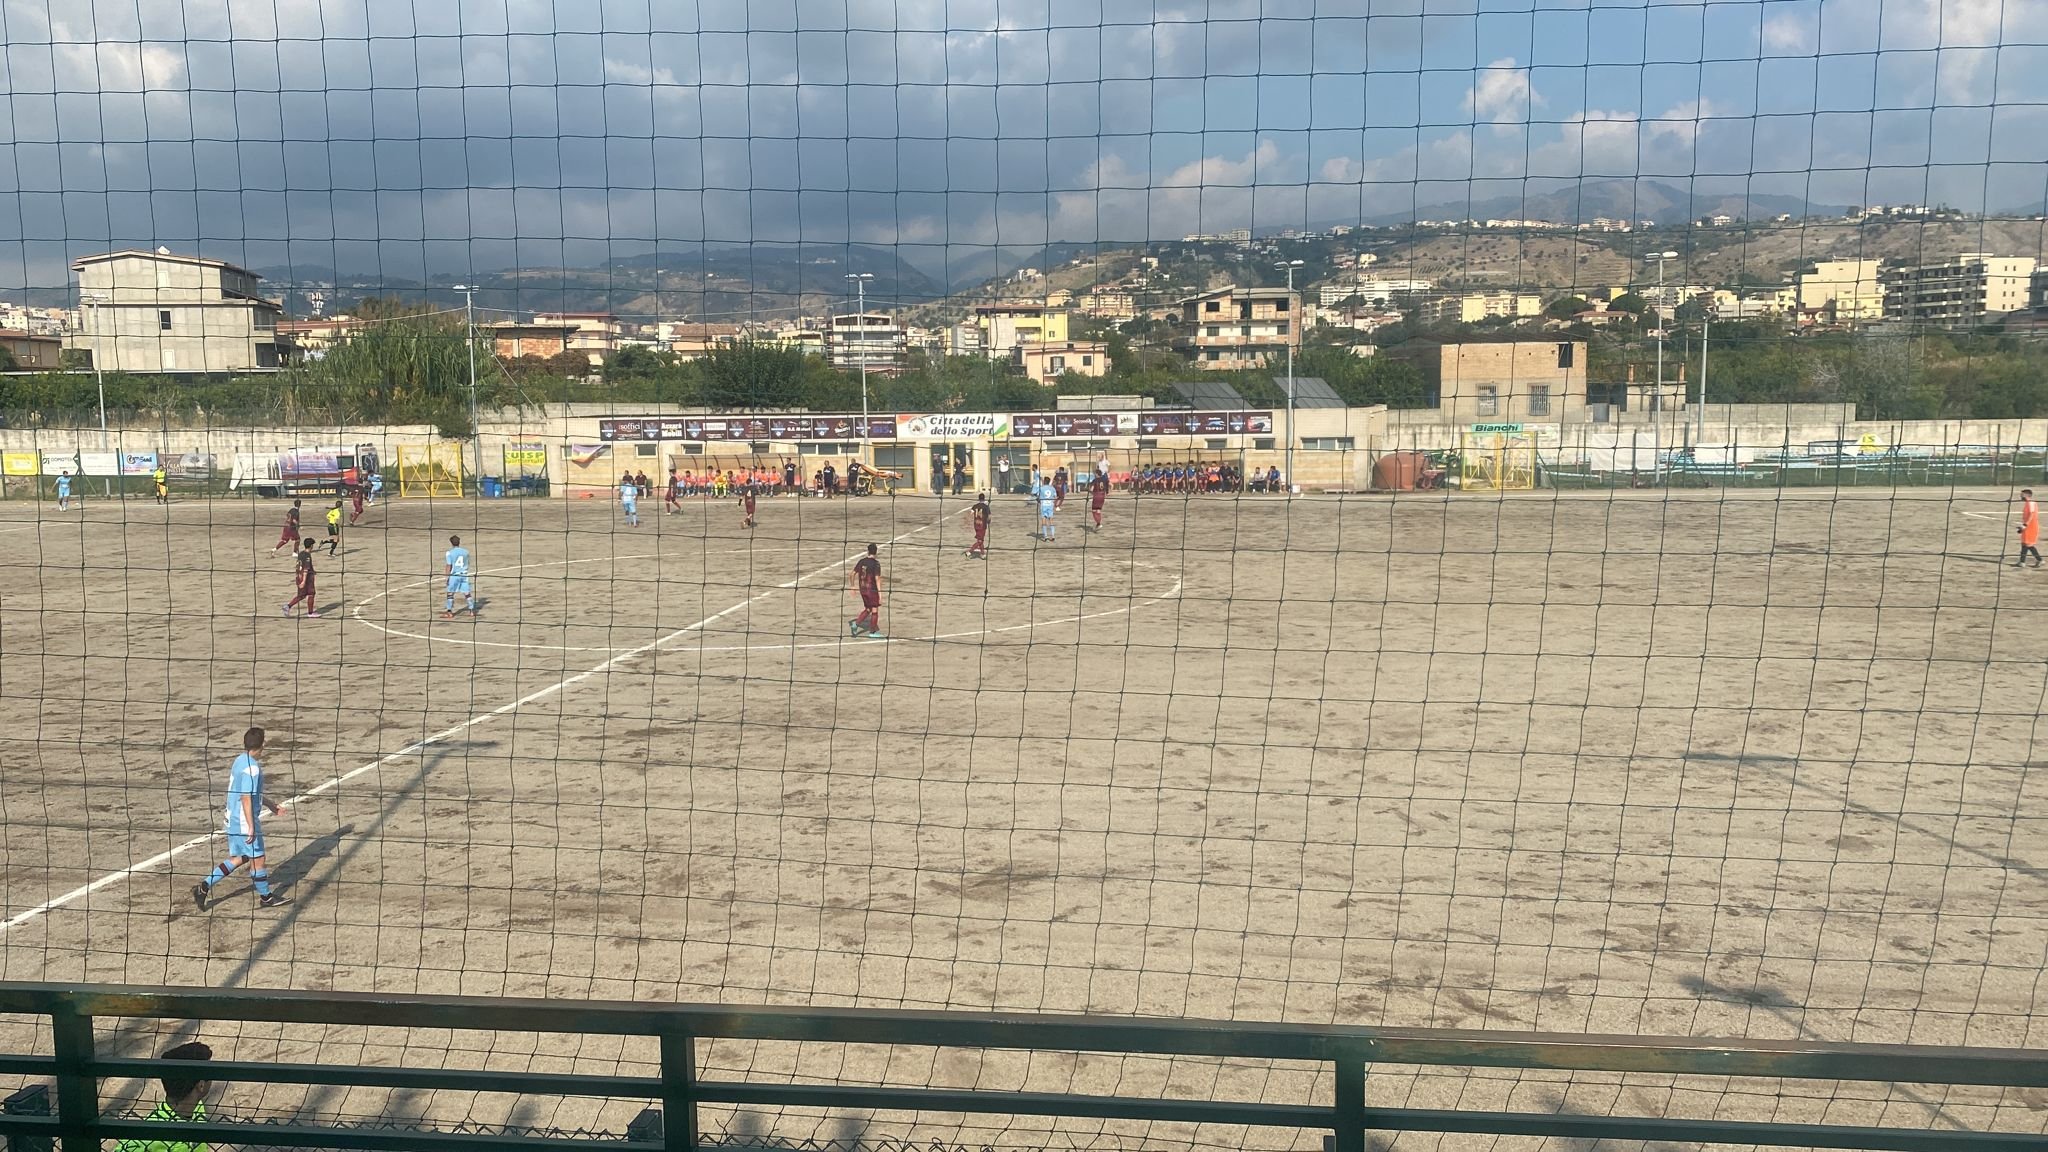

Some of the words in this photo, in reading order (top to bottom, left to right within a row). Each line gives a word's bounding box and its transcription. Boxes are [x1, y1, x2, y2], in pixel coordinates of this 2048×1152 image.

[930, 416, 993, 425] Cittadella
[930, 427, 958, 435] dello
[960, 427, 994, 436] Sport
[1475, 424, 1519, 432] Bianchi
[1044, 489, 1051, 499] 9
[975, 508, 983, 519] 14
[455, 555, 465, 569] 4
